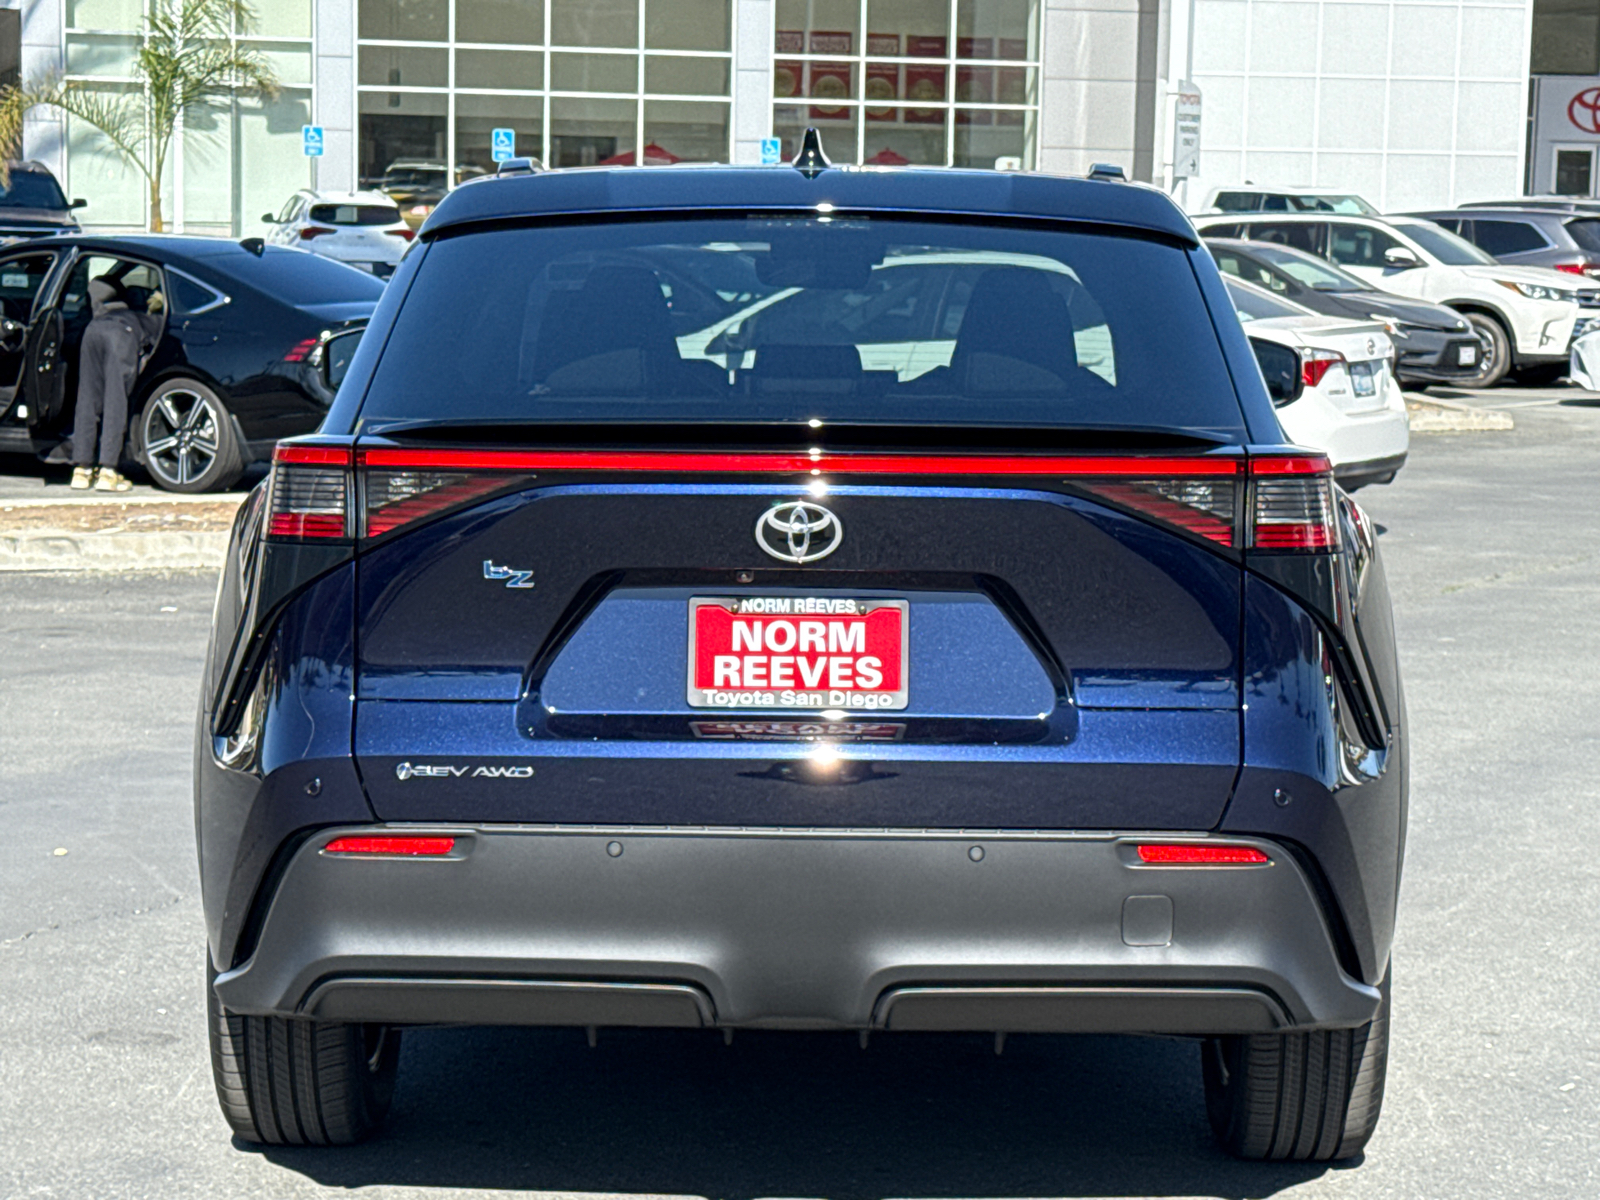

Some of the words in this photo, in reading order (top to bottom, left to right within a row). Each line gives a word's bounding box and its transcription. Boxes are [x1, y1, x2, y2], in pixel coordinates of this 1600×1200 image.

[741, 598, 790, 613] NORM
[794, 598, 856, 614] REEVES
[732, 620, 865, 653] NORM
[713, 655, 884, 688] REEVES
[702, 689, 775, 708] Toyota
[780, 690, 822, 705] San
[829, 691, 893, 709] Diego
[471, 766, 534, 778] AWD
